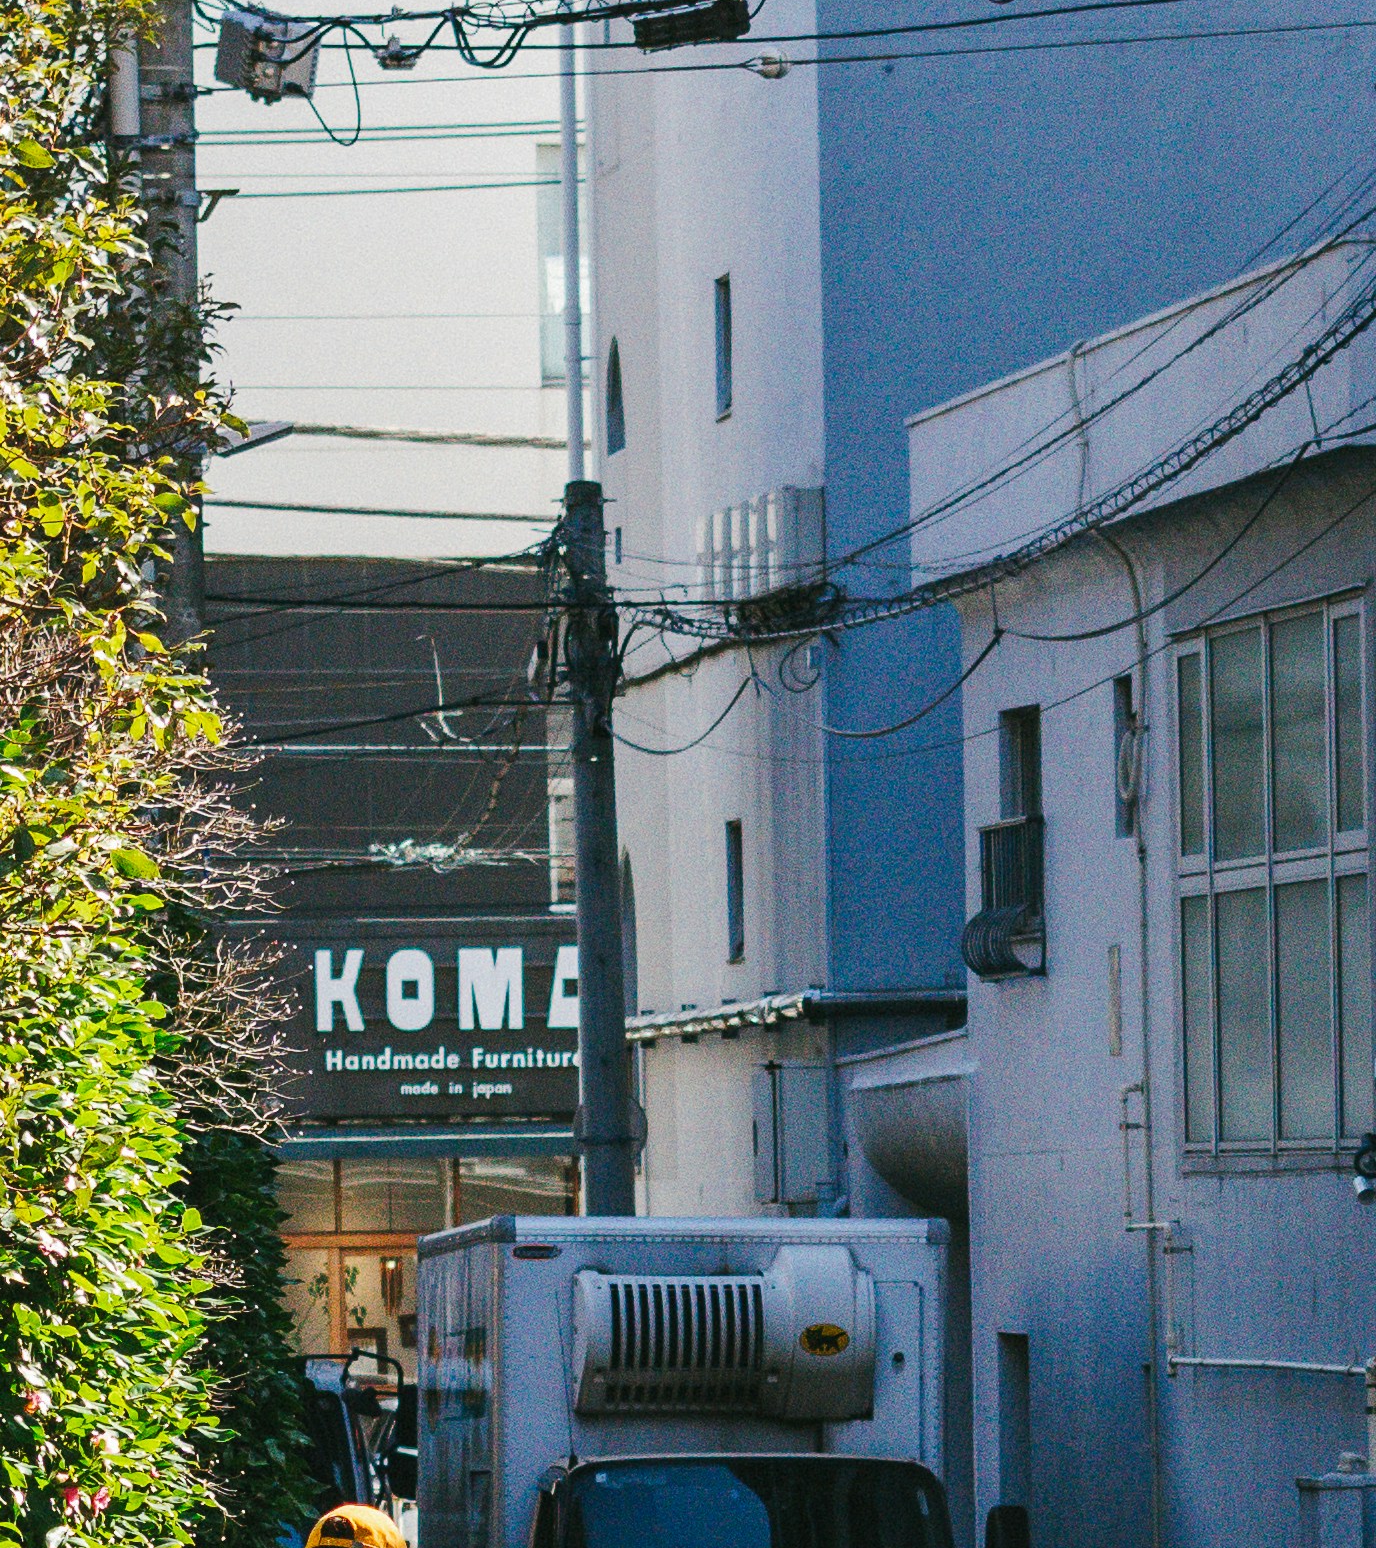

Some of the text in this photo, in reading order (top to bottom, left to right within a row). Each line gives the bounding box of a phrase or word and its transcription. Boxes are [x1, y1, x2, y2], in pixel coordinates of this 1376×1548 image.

[313, 944, 580, 1033] KOMA
[325, 1046, 581, 1072] Handmade Furniture
[400, 1081, 513, 1100] made in japan
